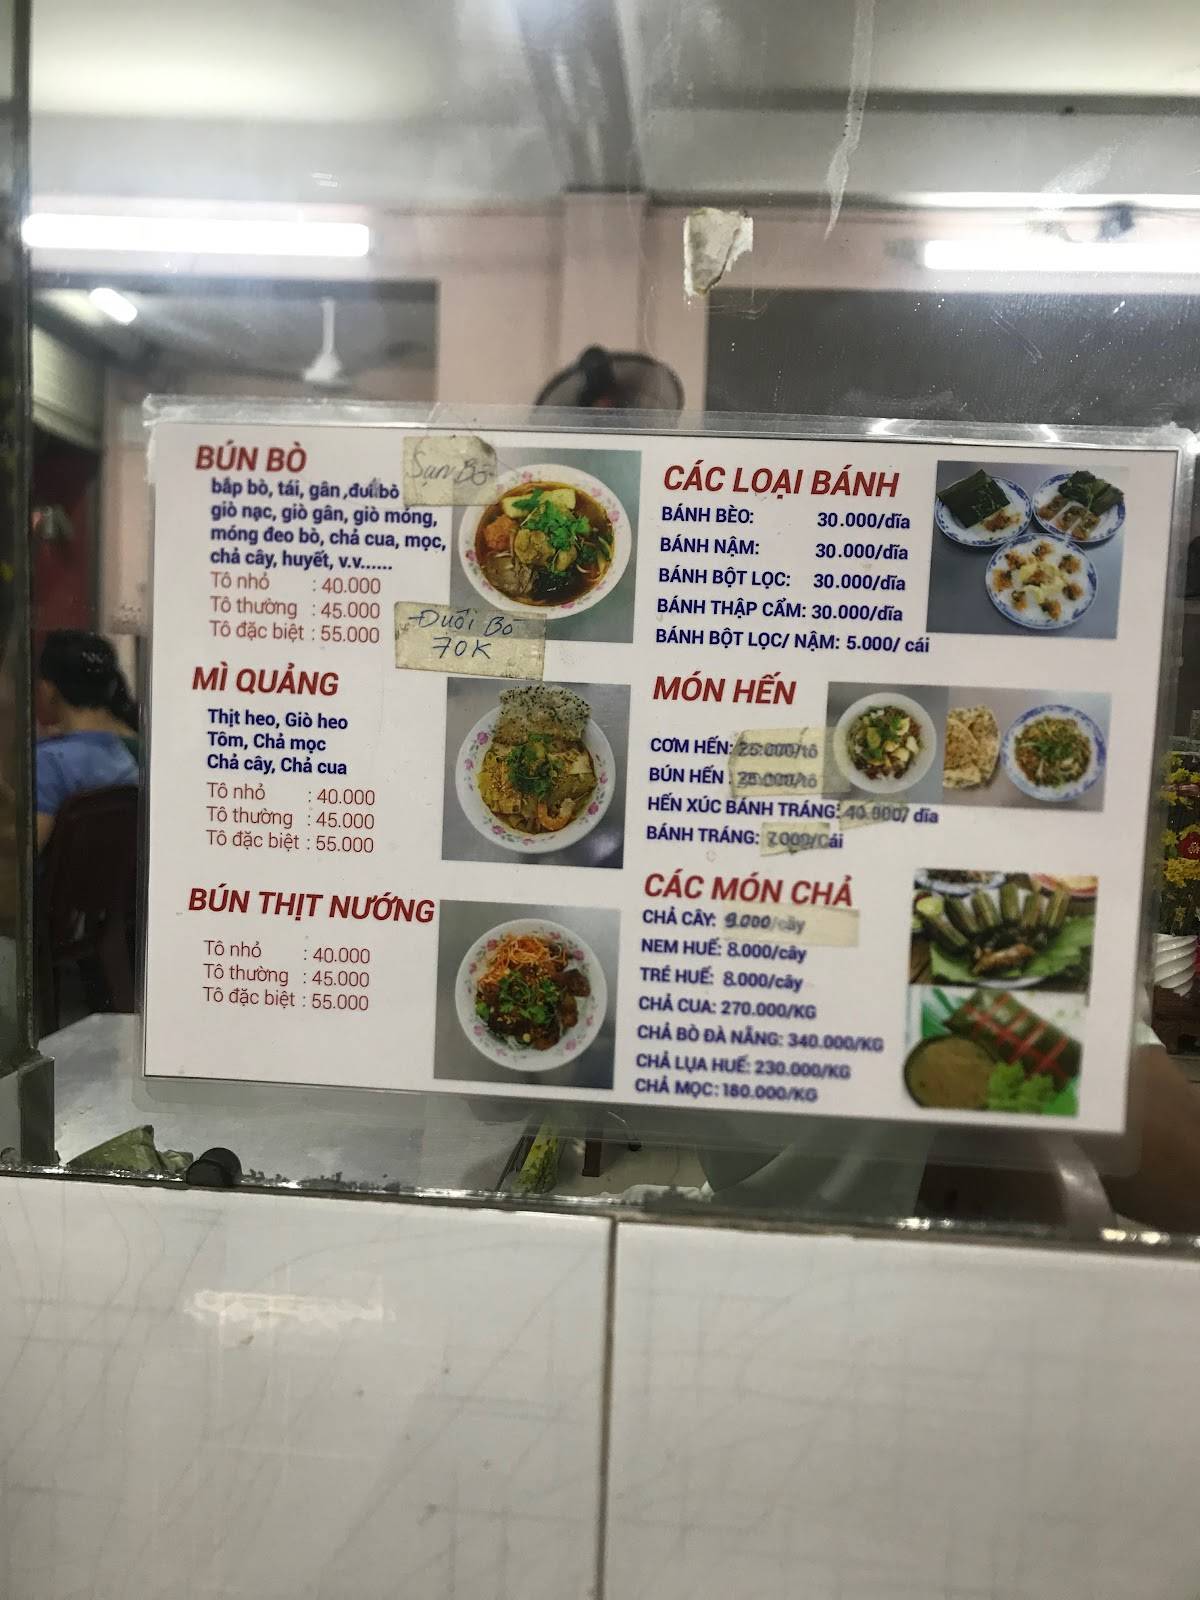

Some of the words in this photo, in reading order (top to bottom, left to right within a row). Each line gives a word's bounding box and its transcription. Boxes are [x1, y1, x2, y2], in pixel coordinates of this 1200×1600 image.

[195, 440, 258, 472] BÚN
[266, 441, 307, 473] BÒ
[247, 479, 273, 497] bò,
[278, 479, 303, 498] tái,
[309, 483, 340, 500] gân
[379, 484, 400, 499] bò
[663, 460, 725, 492] CÁC
[732, 467, 803, 499] LOẠI
[810, 464, 900, 498] BÁNH
[211, 502, 237, 521] giò
[242, 506, 276, 521] nạc,
[282, 504, 308, 522] giò
[312, 505, 348, 524] gân,
[353, 506, 379, 525] giò
[385, 507, 437, 528] móng,
[661, 503, 710, 523] BÁNH
[715, 505, 754, 524] BÈO:
[211, 525, 258, 545] móng
[264, 526, 294, 543] đeo
[299, 527, 324, 546] bò,
[329, 529, 360, 545] chả
[365, 533, 399, 549] cua,
[405, 535, 446, 551] mọc,
[660, 534, 709, 553] BÁNH
[714, 536, 760, 557] NẬM:
[210, 547, 240, 564] chả
[245, 549, 277, 569] cây,
[283, 550, 333, 570] huyết,
[210, 571, 232, 589] Tô
[237, 572, 270, 590] nhỏ
[322, 577, 381, 594] 40.000
[659, 565, 707, 585] BÁNH
[712, 567, 748, 588] BỘT
[751, 571, 791, 590] LỌC:
[209, 595, 231, 613] Tô
[237, 596, 297, 619] thường
[321, 602, 380, 619] 45.000
[657, 595, 706, 615] BÁNH
[711, 598, 758, 619] THẬP
[762, 597, 807, 618] CẨM:
[209, 620, 231, 637] Tô
[236, 621, 267, 640] đặc
[273, 622, 304, 643] biệt
[320, 626, 380, 644] 55.000
[655, 626, 704, 645] BÁNH
[709, 627, 743, 648] BỘT
[748, 632, 790, 650] LỌC/
[794, 631, 840, 652] NẬM:
[846, 636, 900, 653] 5.000/
[905, 637, 930, 653] cái
[192, 661, 228, 690] MÌ
[236, 662, 339, 696] QUẢNG
[652, 671, 726, 702] MÓN
[732, 671, 797, 705] HẾN
[208, 708, 241, 727] Thịt
[245, 709, 280, 729] heo,
[285, 711, 313, 728] Giò
[318, 713, 349, 730] heo
[208, 732, 248, 750] Tôm,
[253, 733, 286, 750] Chả
[290, 737, 326, 753] mọc
[650, 737, 693, 754] CƠM
[694, 735, 734, 756] HẾN:
[207, 753, 239, 770] Chả
[244, 756, 276, 775] cây,
[281, 756, 313, 773] Chả
[317, 761, 348, 775] cua
[649, 764, 685, 782] BÚN
[689, 764, 724, 784] HẾN
[206, 782, 228, 799] Tô
[234, 783, 266, 800] nhỏ
[316, 788, 375, 806] 40.000
[648, 793, 682, 812] HẾN
[687, 795, 722, 813] XÚC
[726, 797, 773, 816] BÁNH
[779, 800, 840, 819] TRÁNG:
[206, 806, 228, 823] Tô
[233, 807, 293, 829] thường
[316, 812, 375, 829] 45.000
[206, 829, 227, 846] Tô
[233, 830, 263, 850] đặc
[268, 831, 300, 852] biệt
[315, 835, 374, 853] 55.000
[646, 824, 693, 843] BÁNH
[698, 826, 759, 846] TRÁNG:
[644, 869, 704, 899] CÁC
[711, 872, 783, 904] MÓN
[791, 874, 853, 907] CHẢ
[188, 883, 250, 913] BÚN
[258, 891, 324, 921] THỊT
[329, 892, 435, 923] NƯỚNG
[642, 906, 677, 925] CHẢ
[682, 909, 716, 927] CÂY:
[203, 940, 225, 956] Tô
[230, 941, 262, 958] nhỏ
[313, 947, 370, 964] 40.000
[641, 938, 678, 954] NEM
[683, 937, 722, 957] HUẾ:
[727, 942, 807, 963] 8.000/cây
[203, 963, 224, 979] Tô
[230, 964, 289, 986] thường
[312, 970, 370, 988] 45.000
[675, 965, 714, 984] HUẾ:
[723, 970, 803, 992] 8.000/cây
[202, 986, 224, 1003] Tô
[229, 988, 259, 1007] đặc
[264, 989, 295, 1009] biệt
[311, 993, 369, 1011] 55.000
[638, 993, 674, 1012] CHẢ
[678, 997, 717, 1014] CUA:
[721, 1000, 817, 1020] 270.000/KG
[637, 1022, 672, 1041] CHẢ
[676, 1023, 700, 1042] BÒ
[704, 1025, 726, 1044] ĐÀ
[788, 1033, 884, 1052] 340.000/KG
[636, 1050, 671, 1069] CHẢ
[675, 1053, 708, 1073] LỤA
[711, 1054, 751, 1075] HUẾ:
[755, 1059, 851, 1080] 230.000/KG
[635, 1076, 670, 1095] CHẢ
[675, 1080, 719, 1099] MỌC:
[723, 1083, 818, 1103] 180.000/KG
